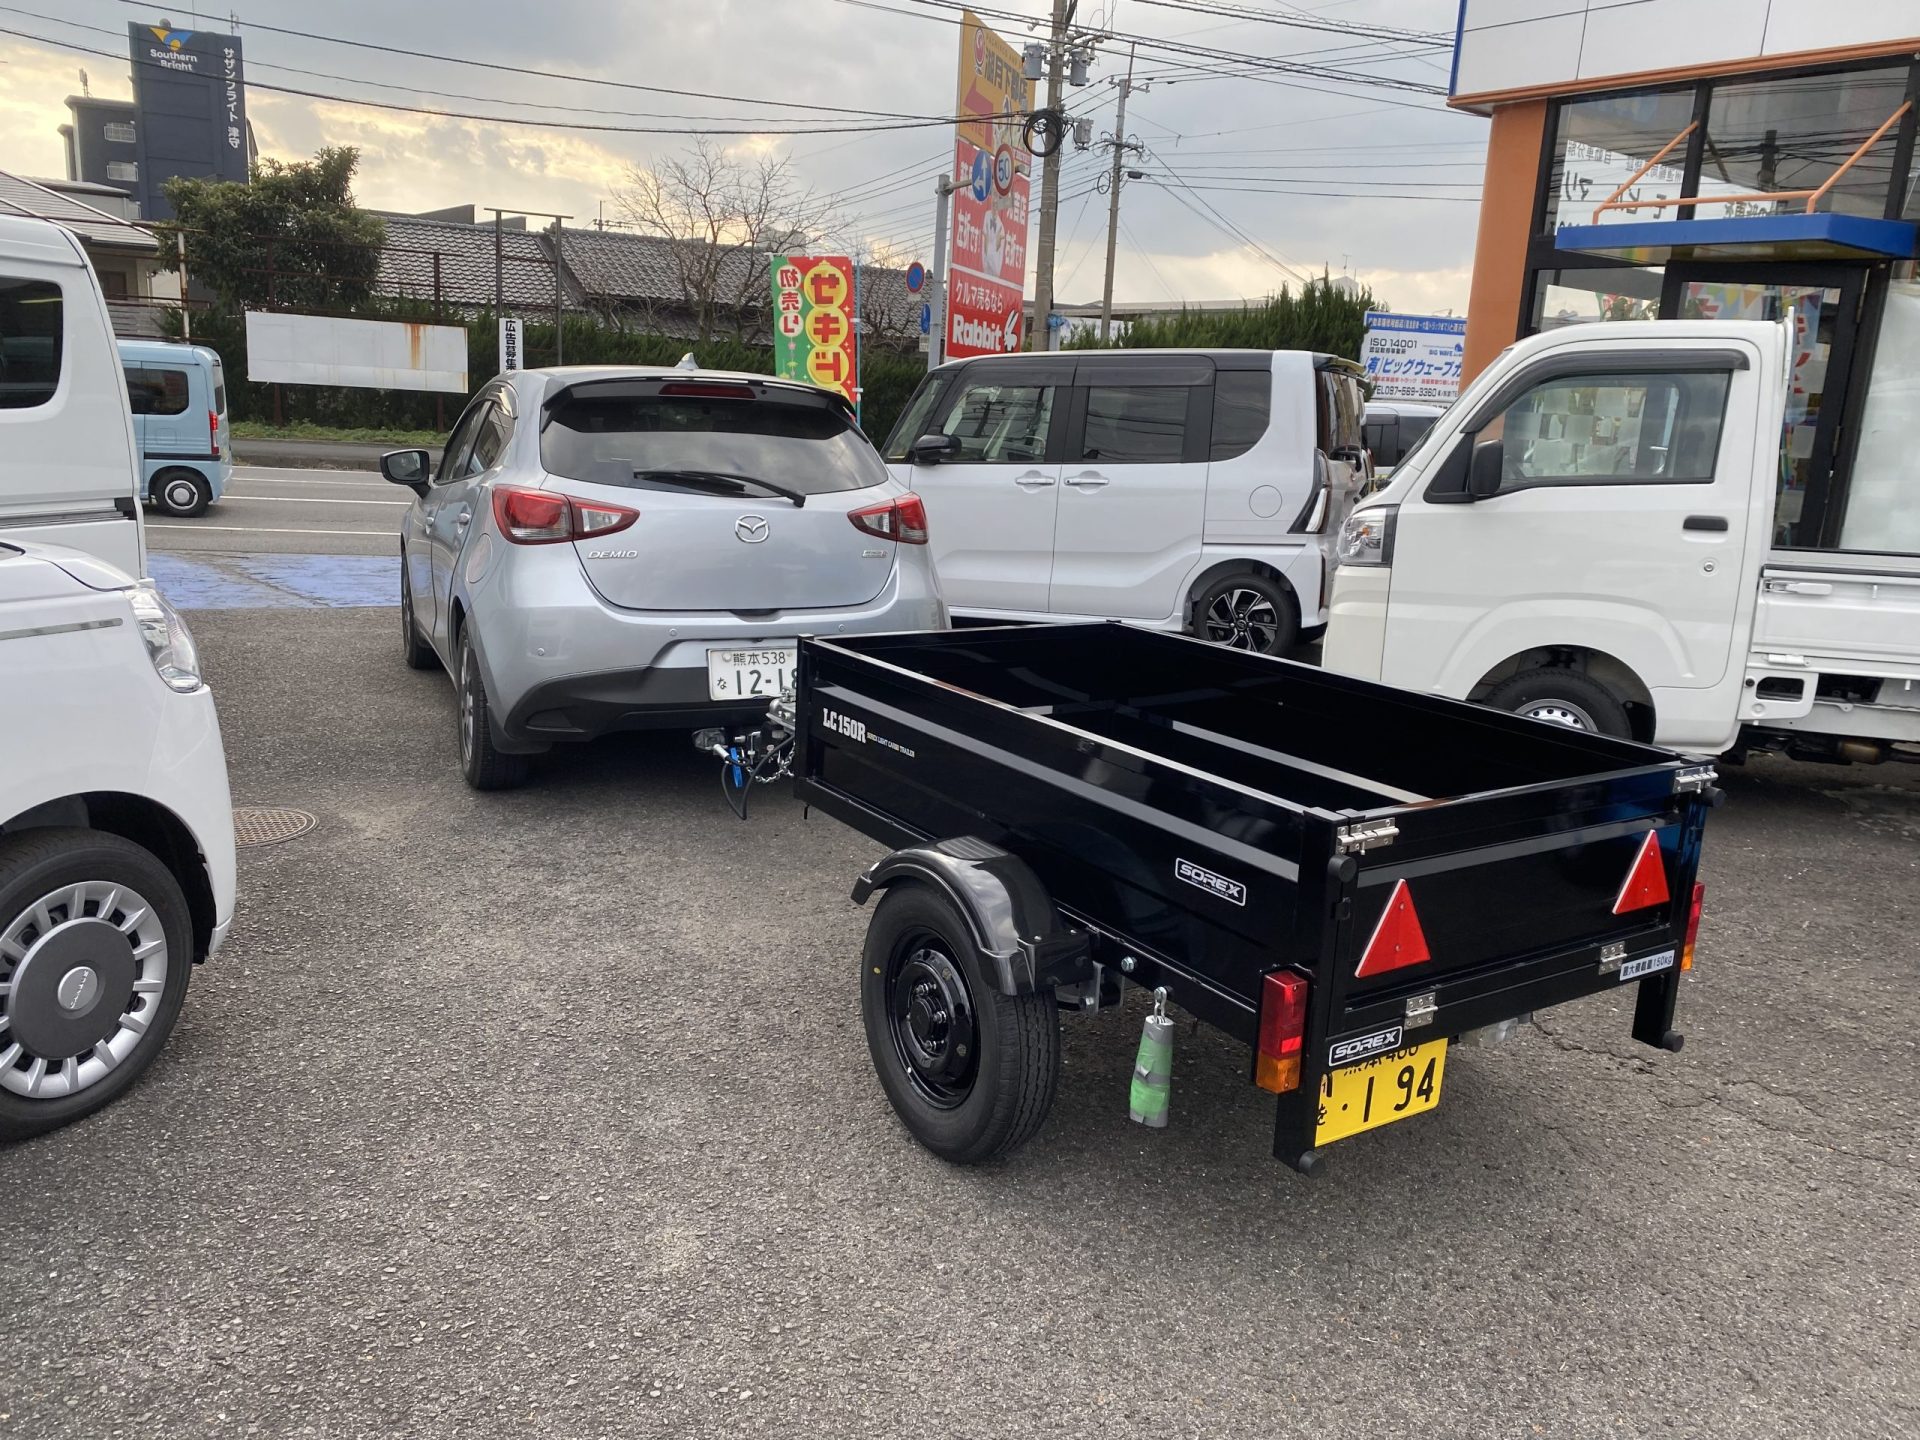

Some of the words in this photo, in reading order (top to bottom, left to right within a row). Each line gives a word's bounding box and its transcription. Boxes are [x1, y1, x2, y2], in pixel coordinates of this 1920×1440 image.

[150, 48, 198, 63] Southern
[160, 59, 193, 71] Bright
[998, 157, 1010, 182] 50
[956, 279, 1003, 314] クルマ売るなら
[505, 320, 516, 370] 広告募集
[952, 314, 1002, 351] Rabbit
[1370, 338, 1387, 347] ISO
[1390, 338, 1418, 349] 14001
[587, 550, 638, 559] DEMIO
[733, 651, 786, 666] 熊本538
[717, 677, 727, 690] な
[823, 707, 866, 744] LC150R
[1180, 864, 1241, 897] SOREX
[1334, 1031, 1398, 1058] SOREX
